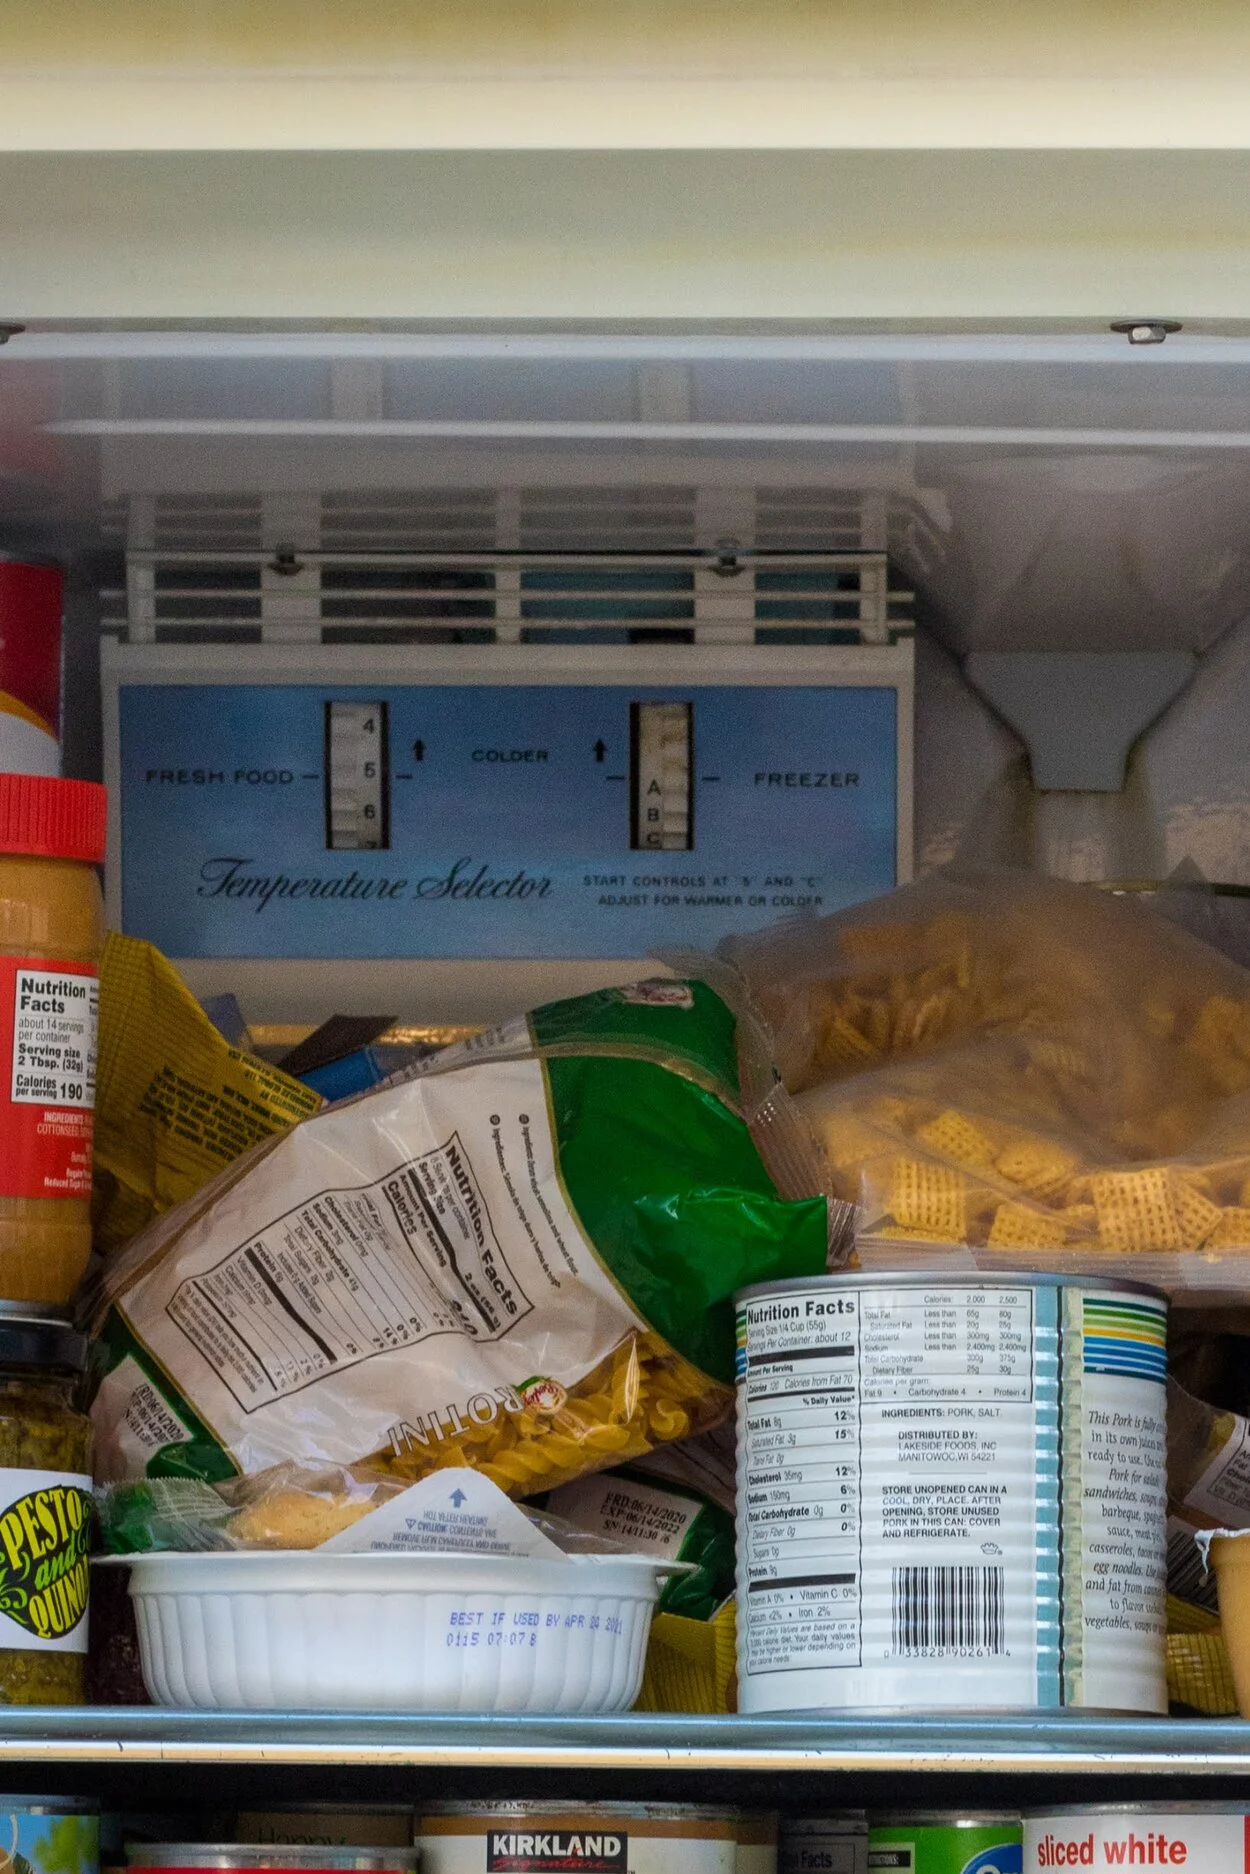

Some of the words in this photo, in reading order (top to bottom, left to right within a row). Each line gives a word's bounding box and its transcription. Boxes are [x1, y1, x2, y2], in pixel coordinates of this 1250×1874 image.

[472, 750, 548, 763] COLDER
[146, 769, 224, 784] FRESH
[234, 771, 294, 784] FOOD
[754, 773, 860, 787] FREEZER
[198, 858, 408, 914] Temperature
[416, 855, 553, 901] Selector
[584, 876, 625, 886] START
[633, 876, 705, 887] CONTROLS
[713, 876, 727, 886] AT
[21, 978, 86, 998] Nutrition
[20, 995, 65, 1013] Facts
[16, 1074, 56, 1089] Calories
[60, 1082, 82, 1100] 190
[747, 1304, 800, 1324] Nutrition
[806, 1300, 855, 1317] Facts
[0, 1489, 82, 1570] PESTO
[35, 1531, 76, 1590] and
[450, 1612, 483, 1625] BEST
[492, 1612, 505, 1625] IF
[513, 1612, 539, 1626] USED
[546, 1614, 560, 1626] BY
[493, 1835, 620, 1857] KIRKLAND
[1038, 1832, 1094, 1867] sliced
[1104, 1834, 1187, 1864] white
[493, 1856, 619, 1871] Signature
